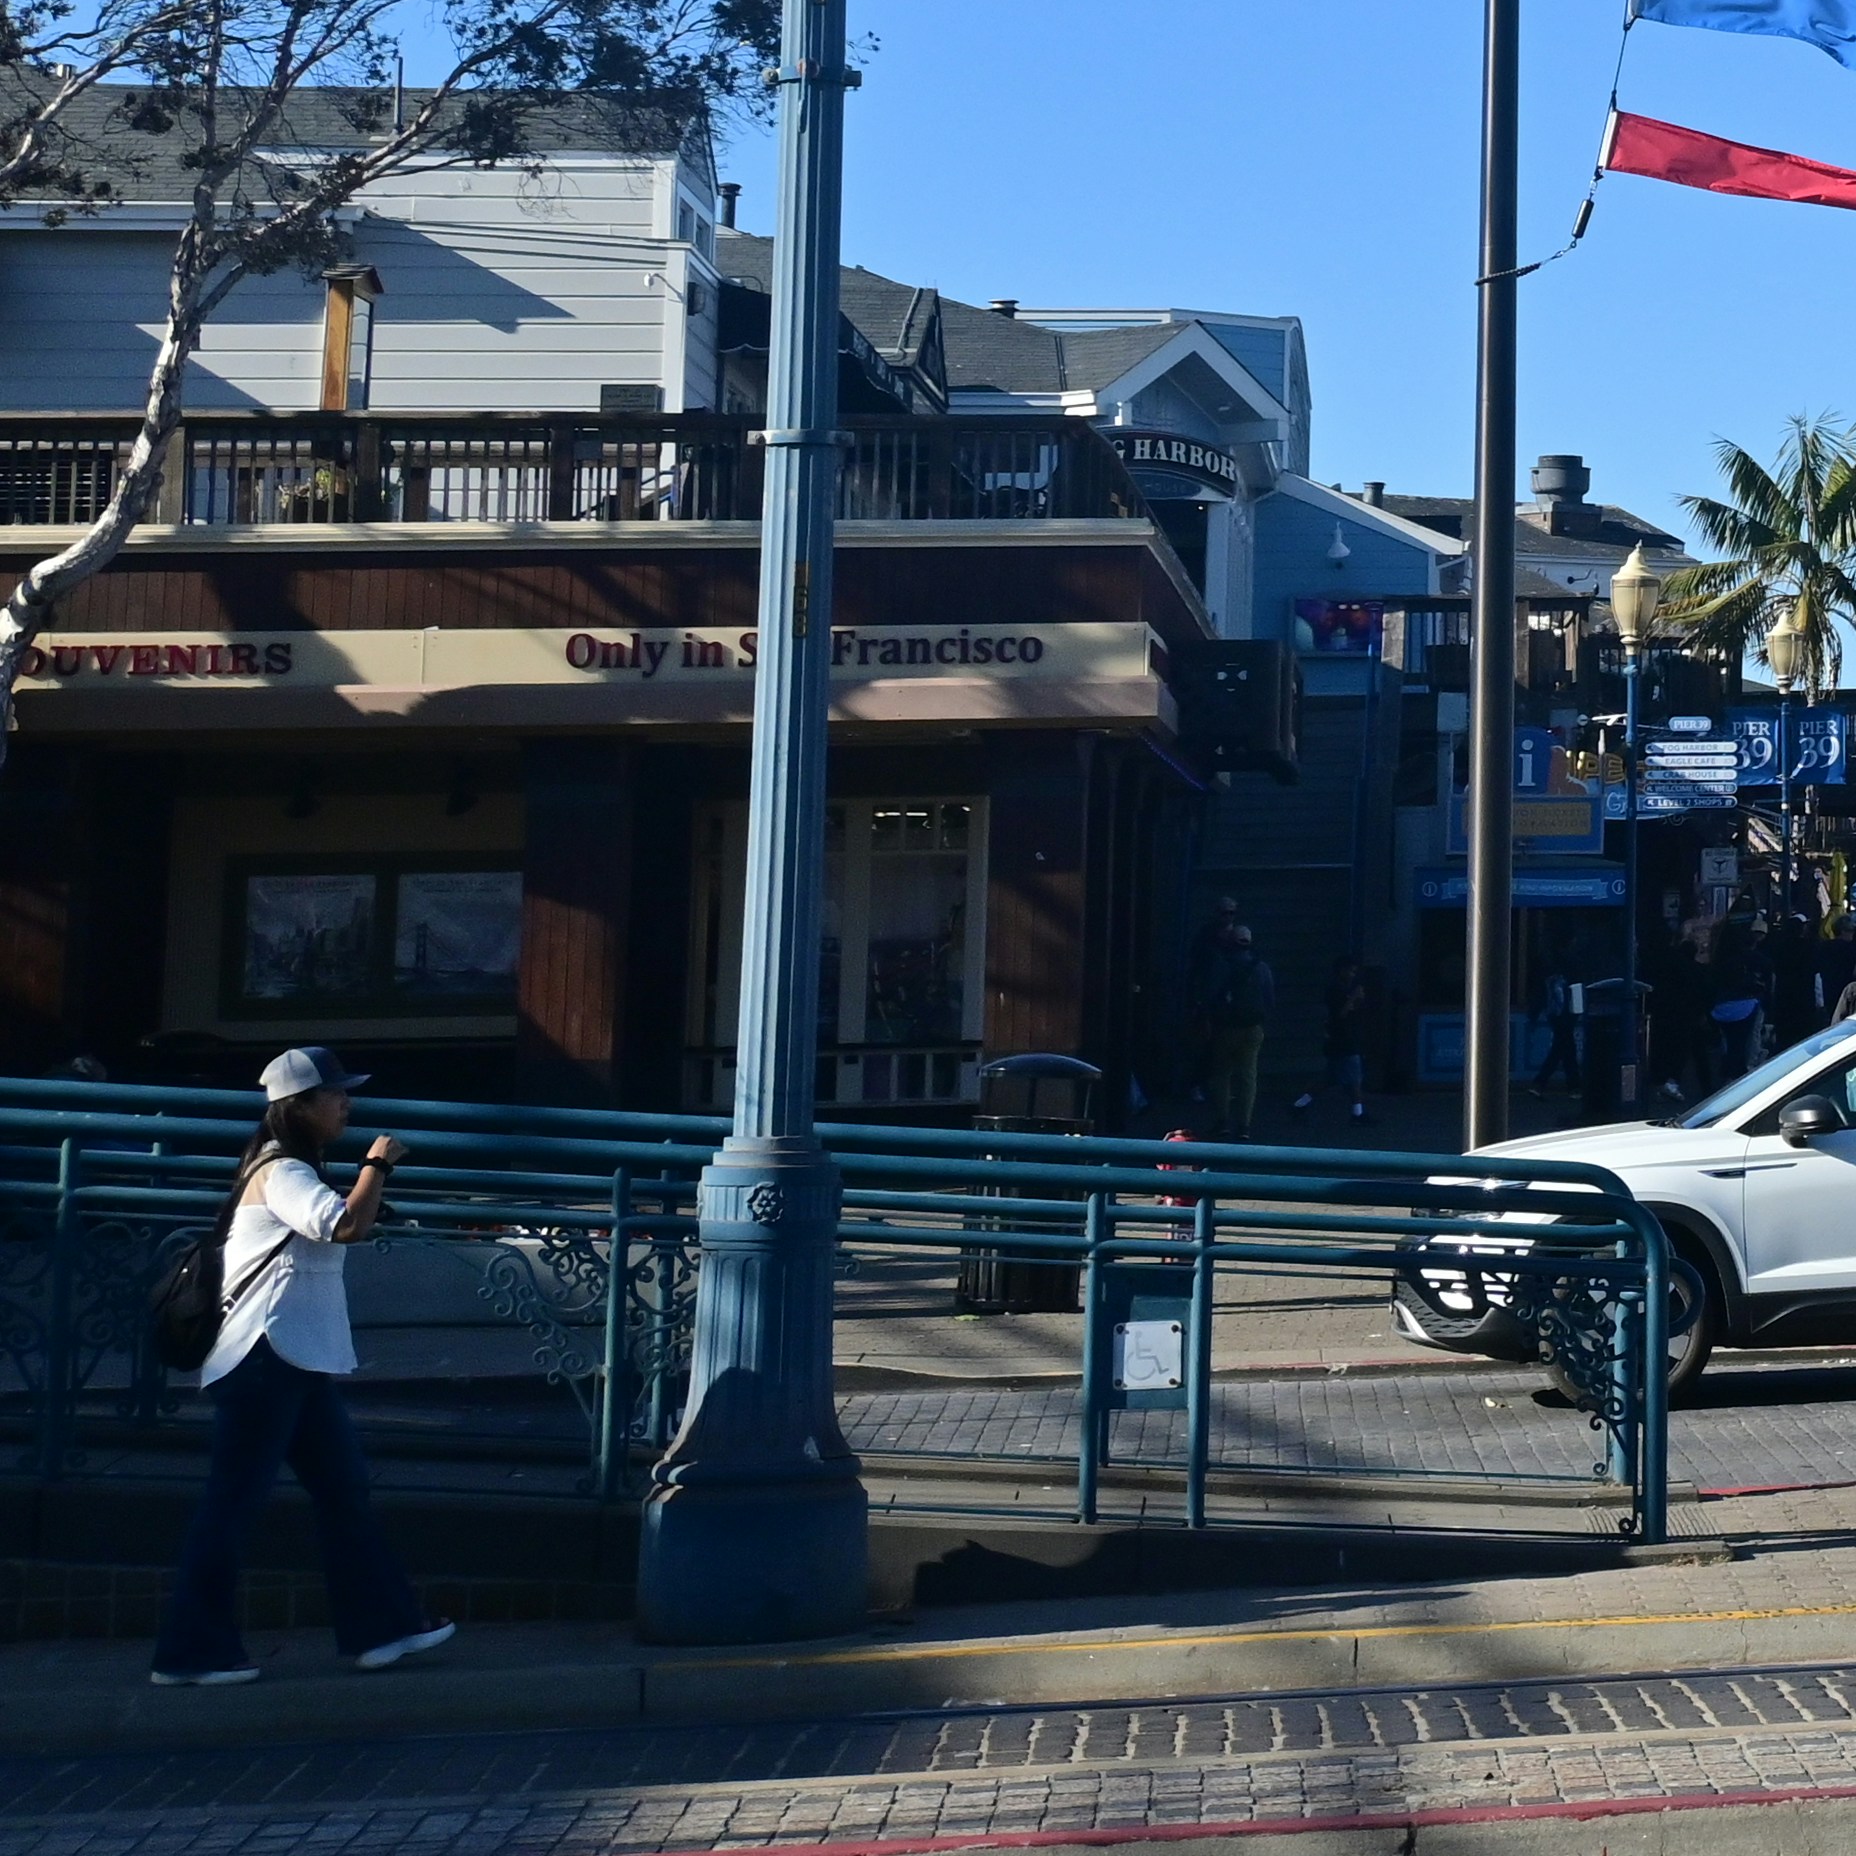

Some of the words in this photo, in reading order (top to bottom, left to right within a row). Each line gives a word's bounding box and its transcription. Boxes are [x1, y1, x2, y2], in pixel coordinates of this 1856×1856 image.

[1133, 439, 1237, 482] HARBOR
[20, 642, 293, 677] OUVENIRS
[564, 631, 670, 679] Only
[681, 631, 725, 669] in
[830, 628, 1045, 668] Francisco
[1673, 720, 1698, 730] PIER
[1732, 721, 1771, 737] PIER
[1799, 719, 1840, 736] PIER
[1682, 744, 1719, 752] HARBOR
[1734, 736, 1774, 771] 39
[1798, 735, 1841, 770] 39
[1664, 757, 1692, 765] EAGLE
[1694, 757, 1717, 765] CAFE
[1687, 771, 1718, 779] HOUSE
[1693, 798, 1723, 806] SHOPS
